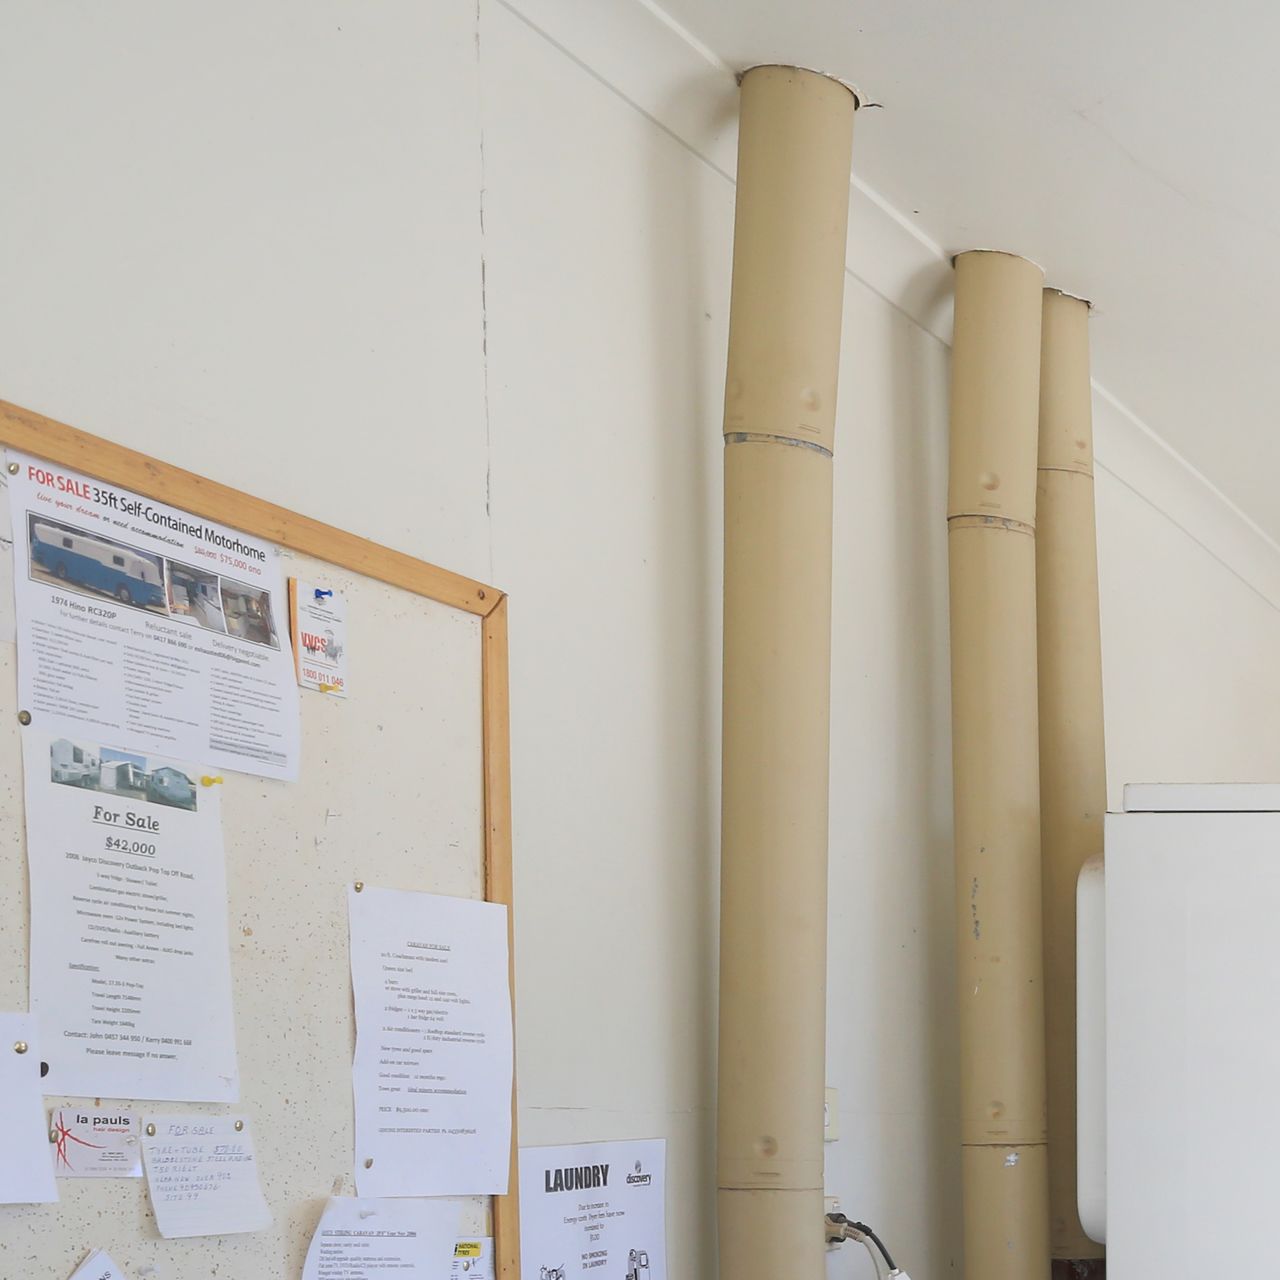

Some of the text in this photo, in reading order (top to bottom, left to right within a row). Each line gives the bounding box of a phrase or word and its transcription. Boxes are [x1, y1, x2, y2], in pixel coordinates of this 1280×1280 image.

[28, 466, 266, 561] FOR SALE 35ft Self-Contained Motorhome
[51, 596, 68, 607] 1974
[93, 805, 160, 832] For Sale
[105, 836, 156, 856] $42,000
[76, 1114, 130, 1128] la pauls
[544, 1164, 652, 1193] LAUNDRY discovery
